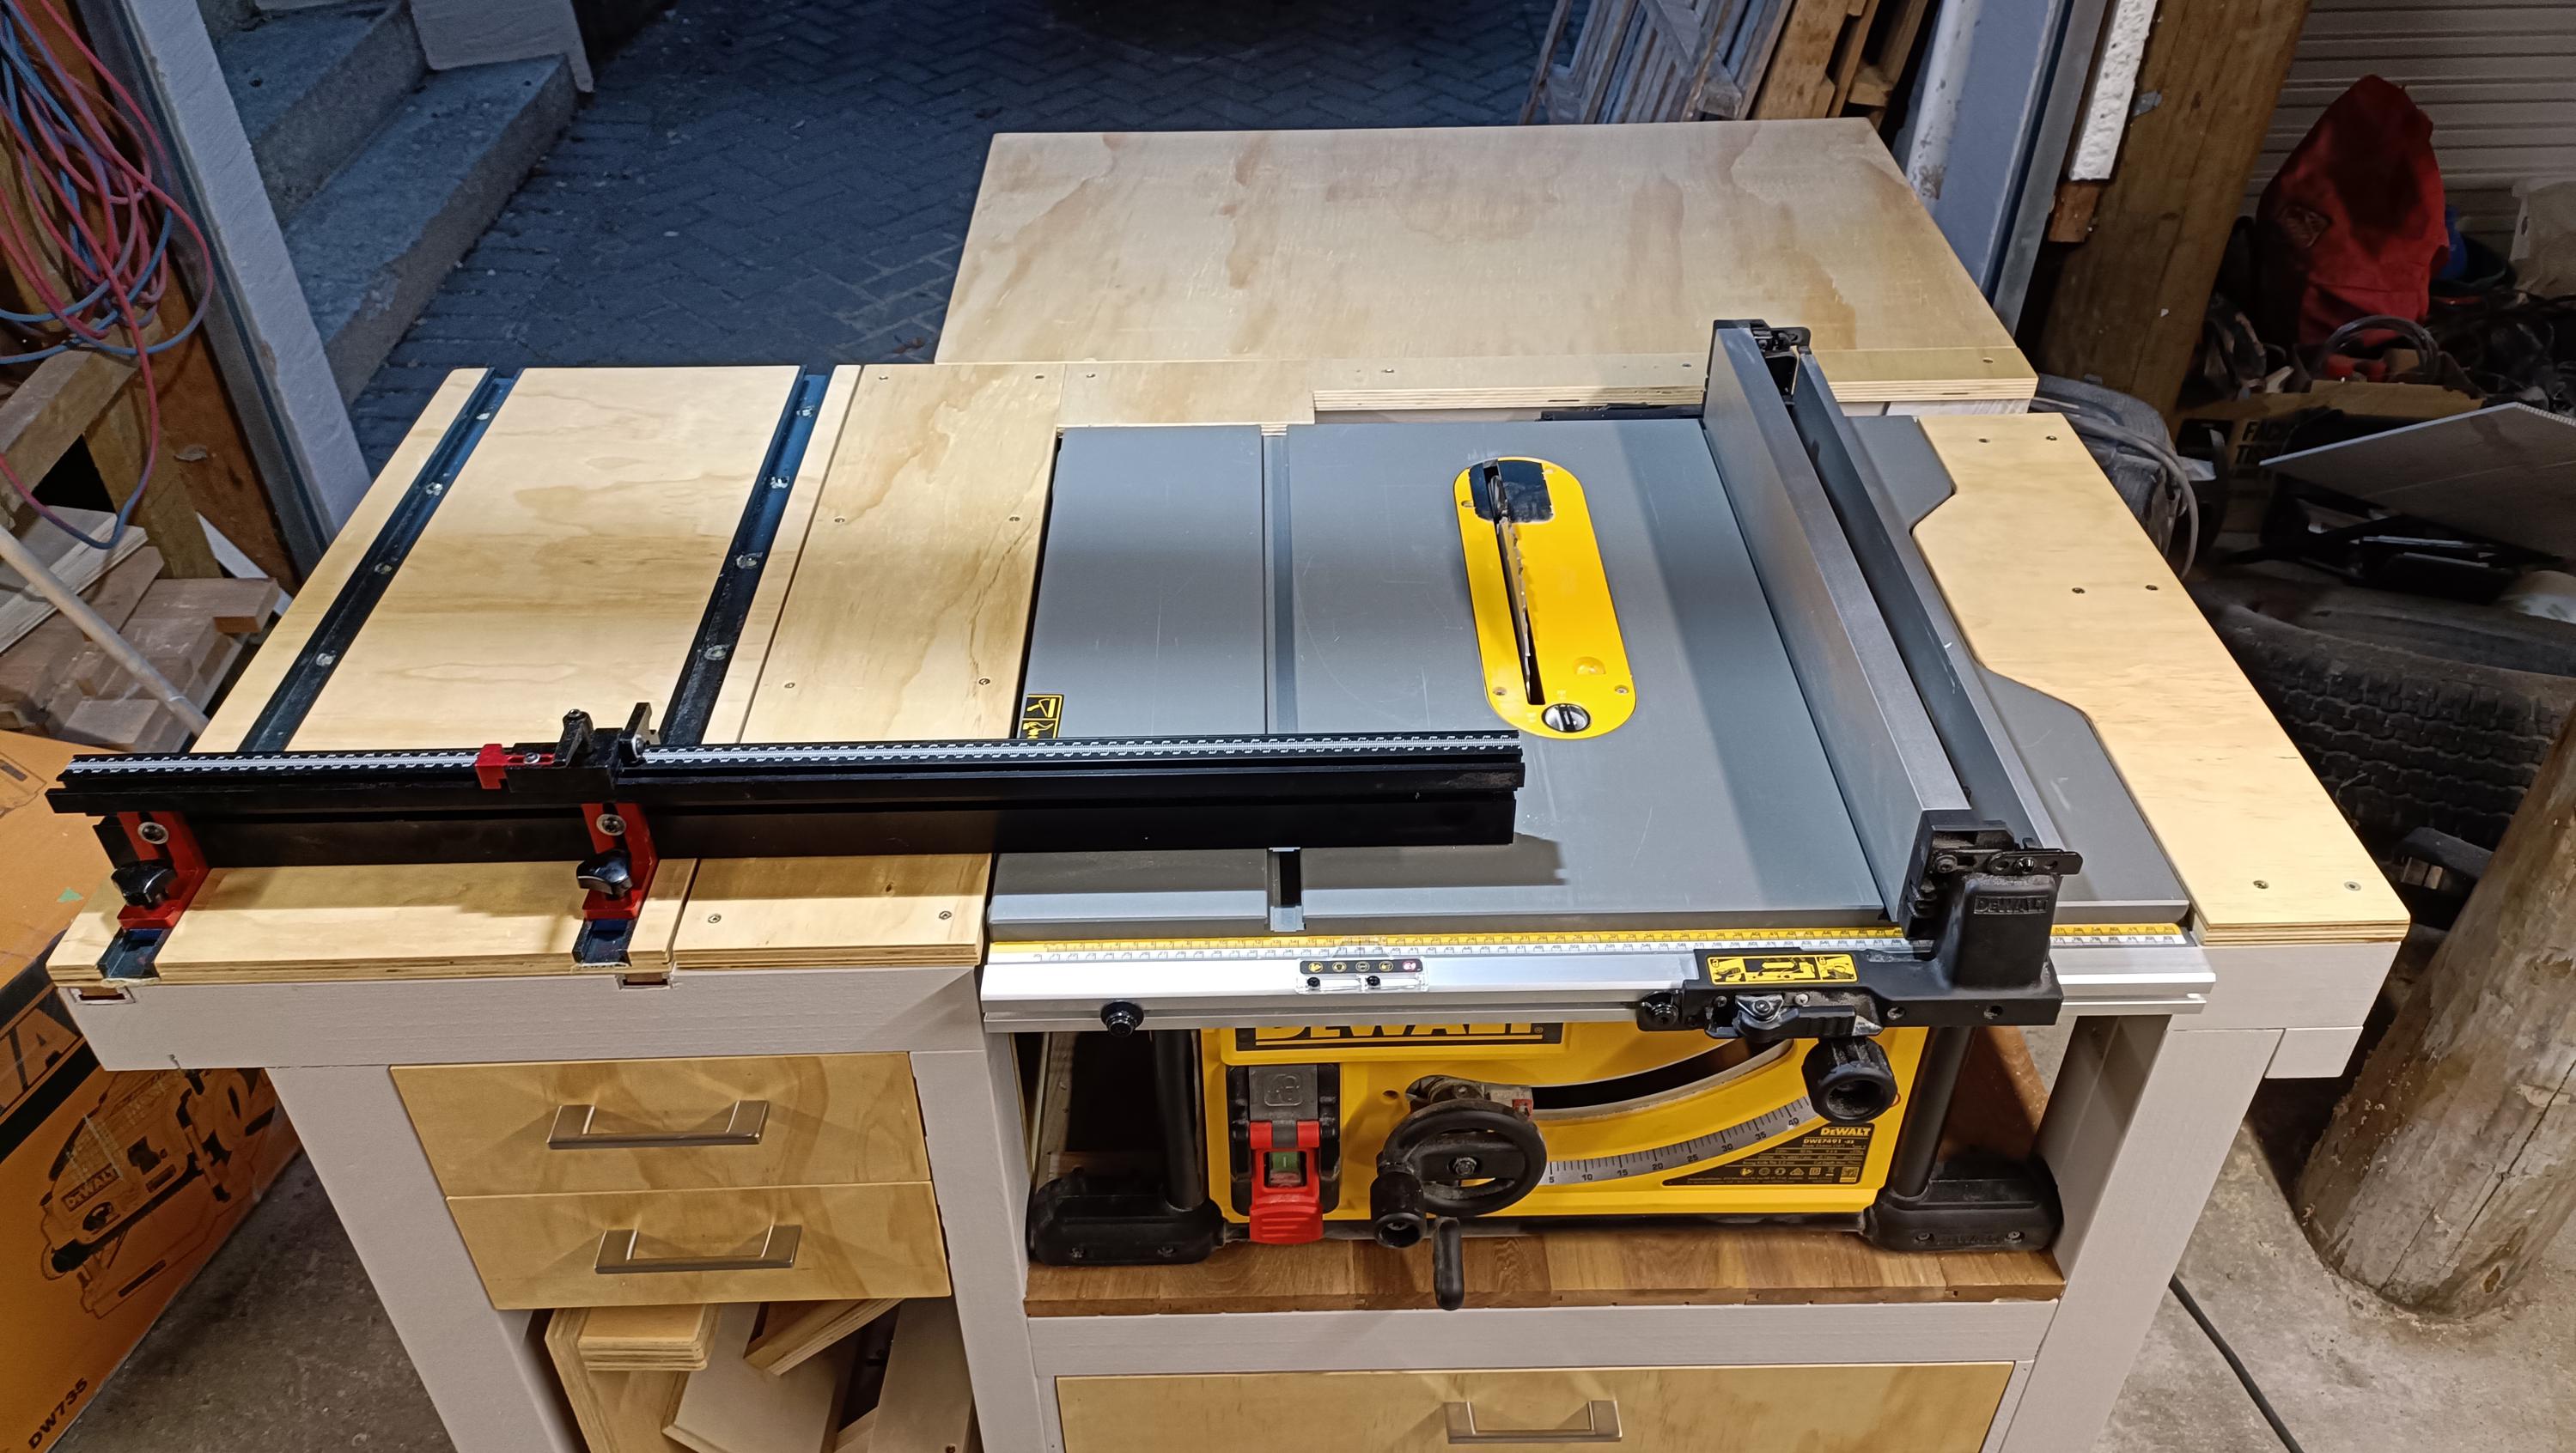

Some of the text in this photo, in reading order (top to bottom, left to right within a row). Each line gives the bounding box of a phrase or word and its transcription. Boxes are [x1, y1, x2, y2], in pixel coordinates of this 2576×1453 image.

[1721, 1143, 1733, 1152] 30
[1755, 1132, 1767, 1140] 35
[1788, 1118, 1800, 1127] 40
[28, 1377, 88, 1450] DW735
